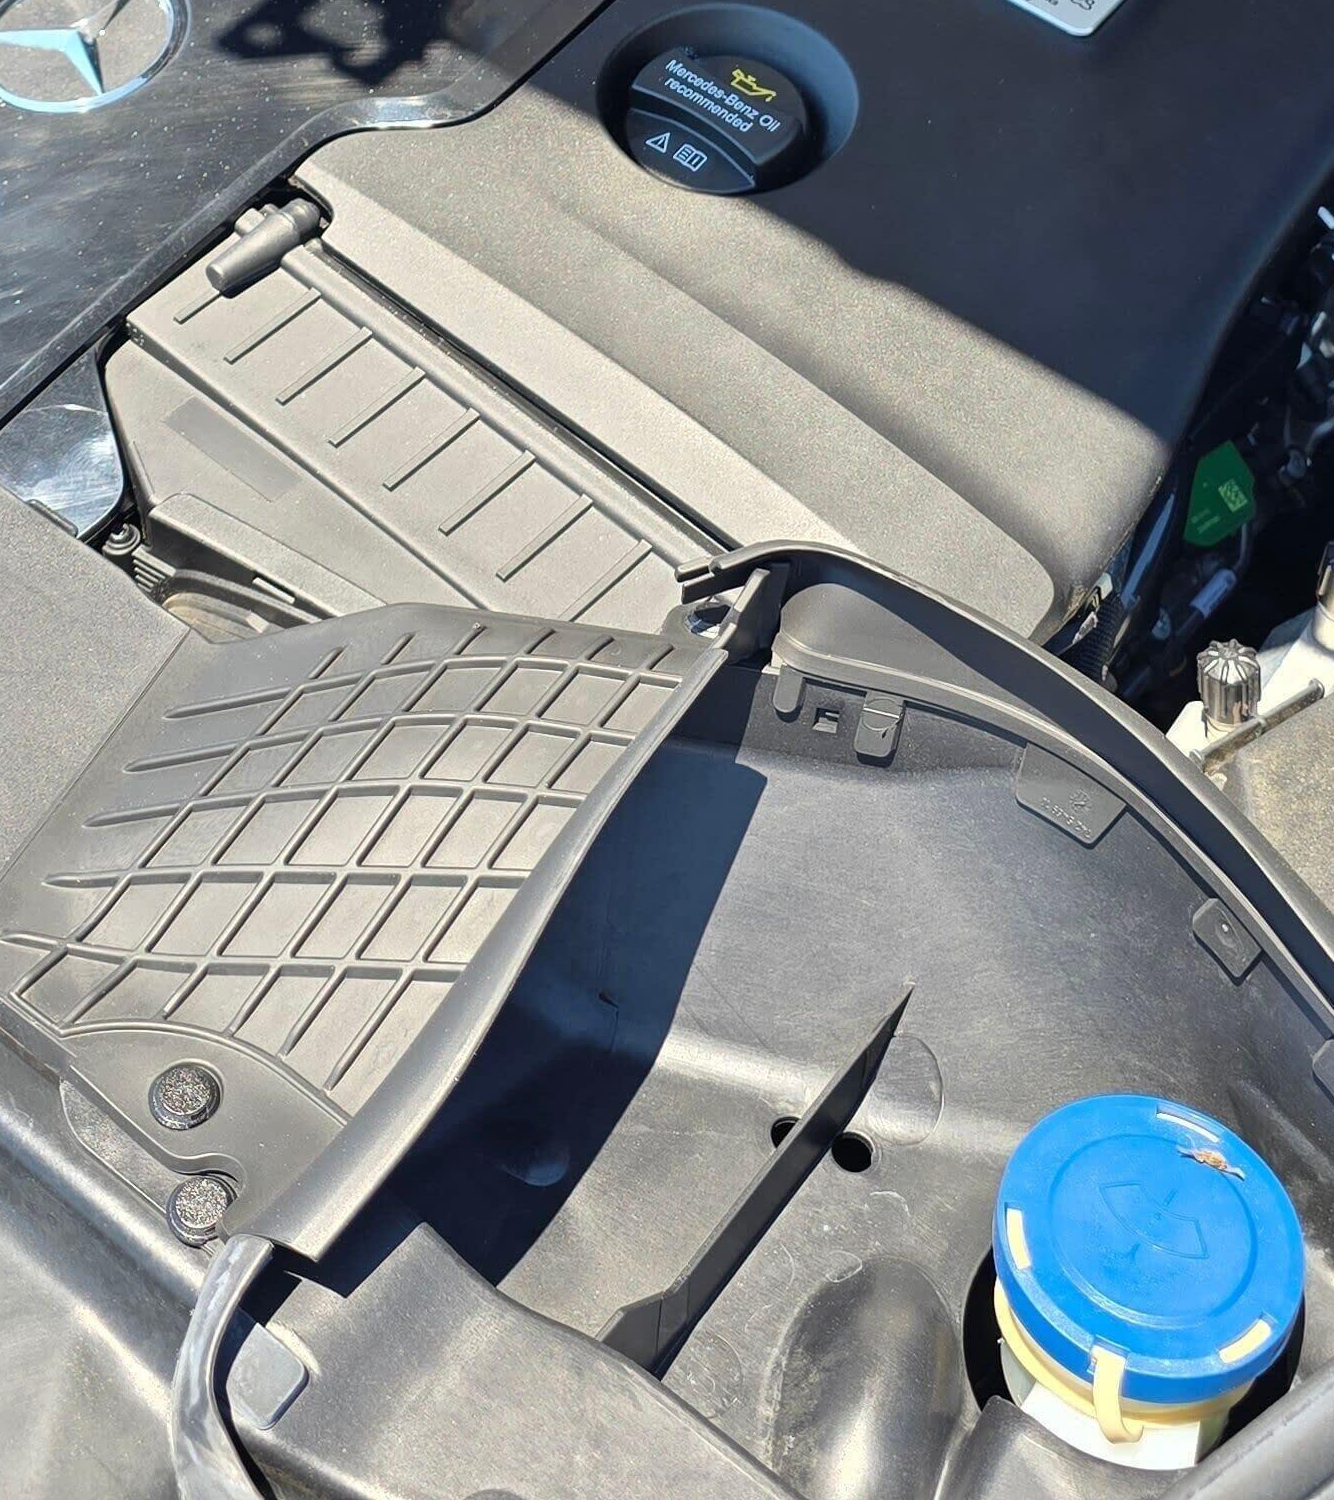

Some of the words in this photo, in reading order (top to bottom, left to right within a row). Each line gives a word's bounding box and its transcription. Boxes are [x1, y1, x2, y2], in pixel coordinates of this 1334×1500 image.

[664, 76, 753, 133] recommended
[665, 59, 757, 120] Mercedes-Benz
[759, 112, 781, 132] Oil
